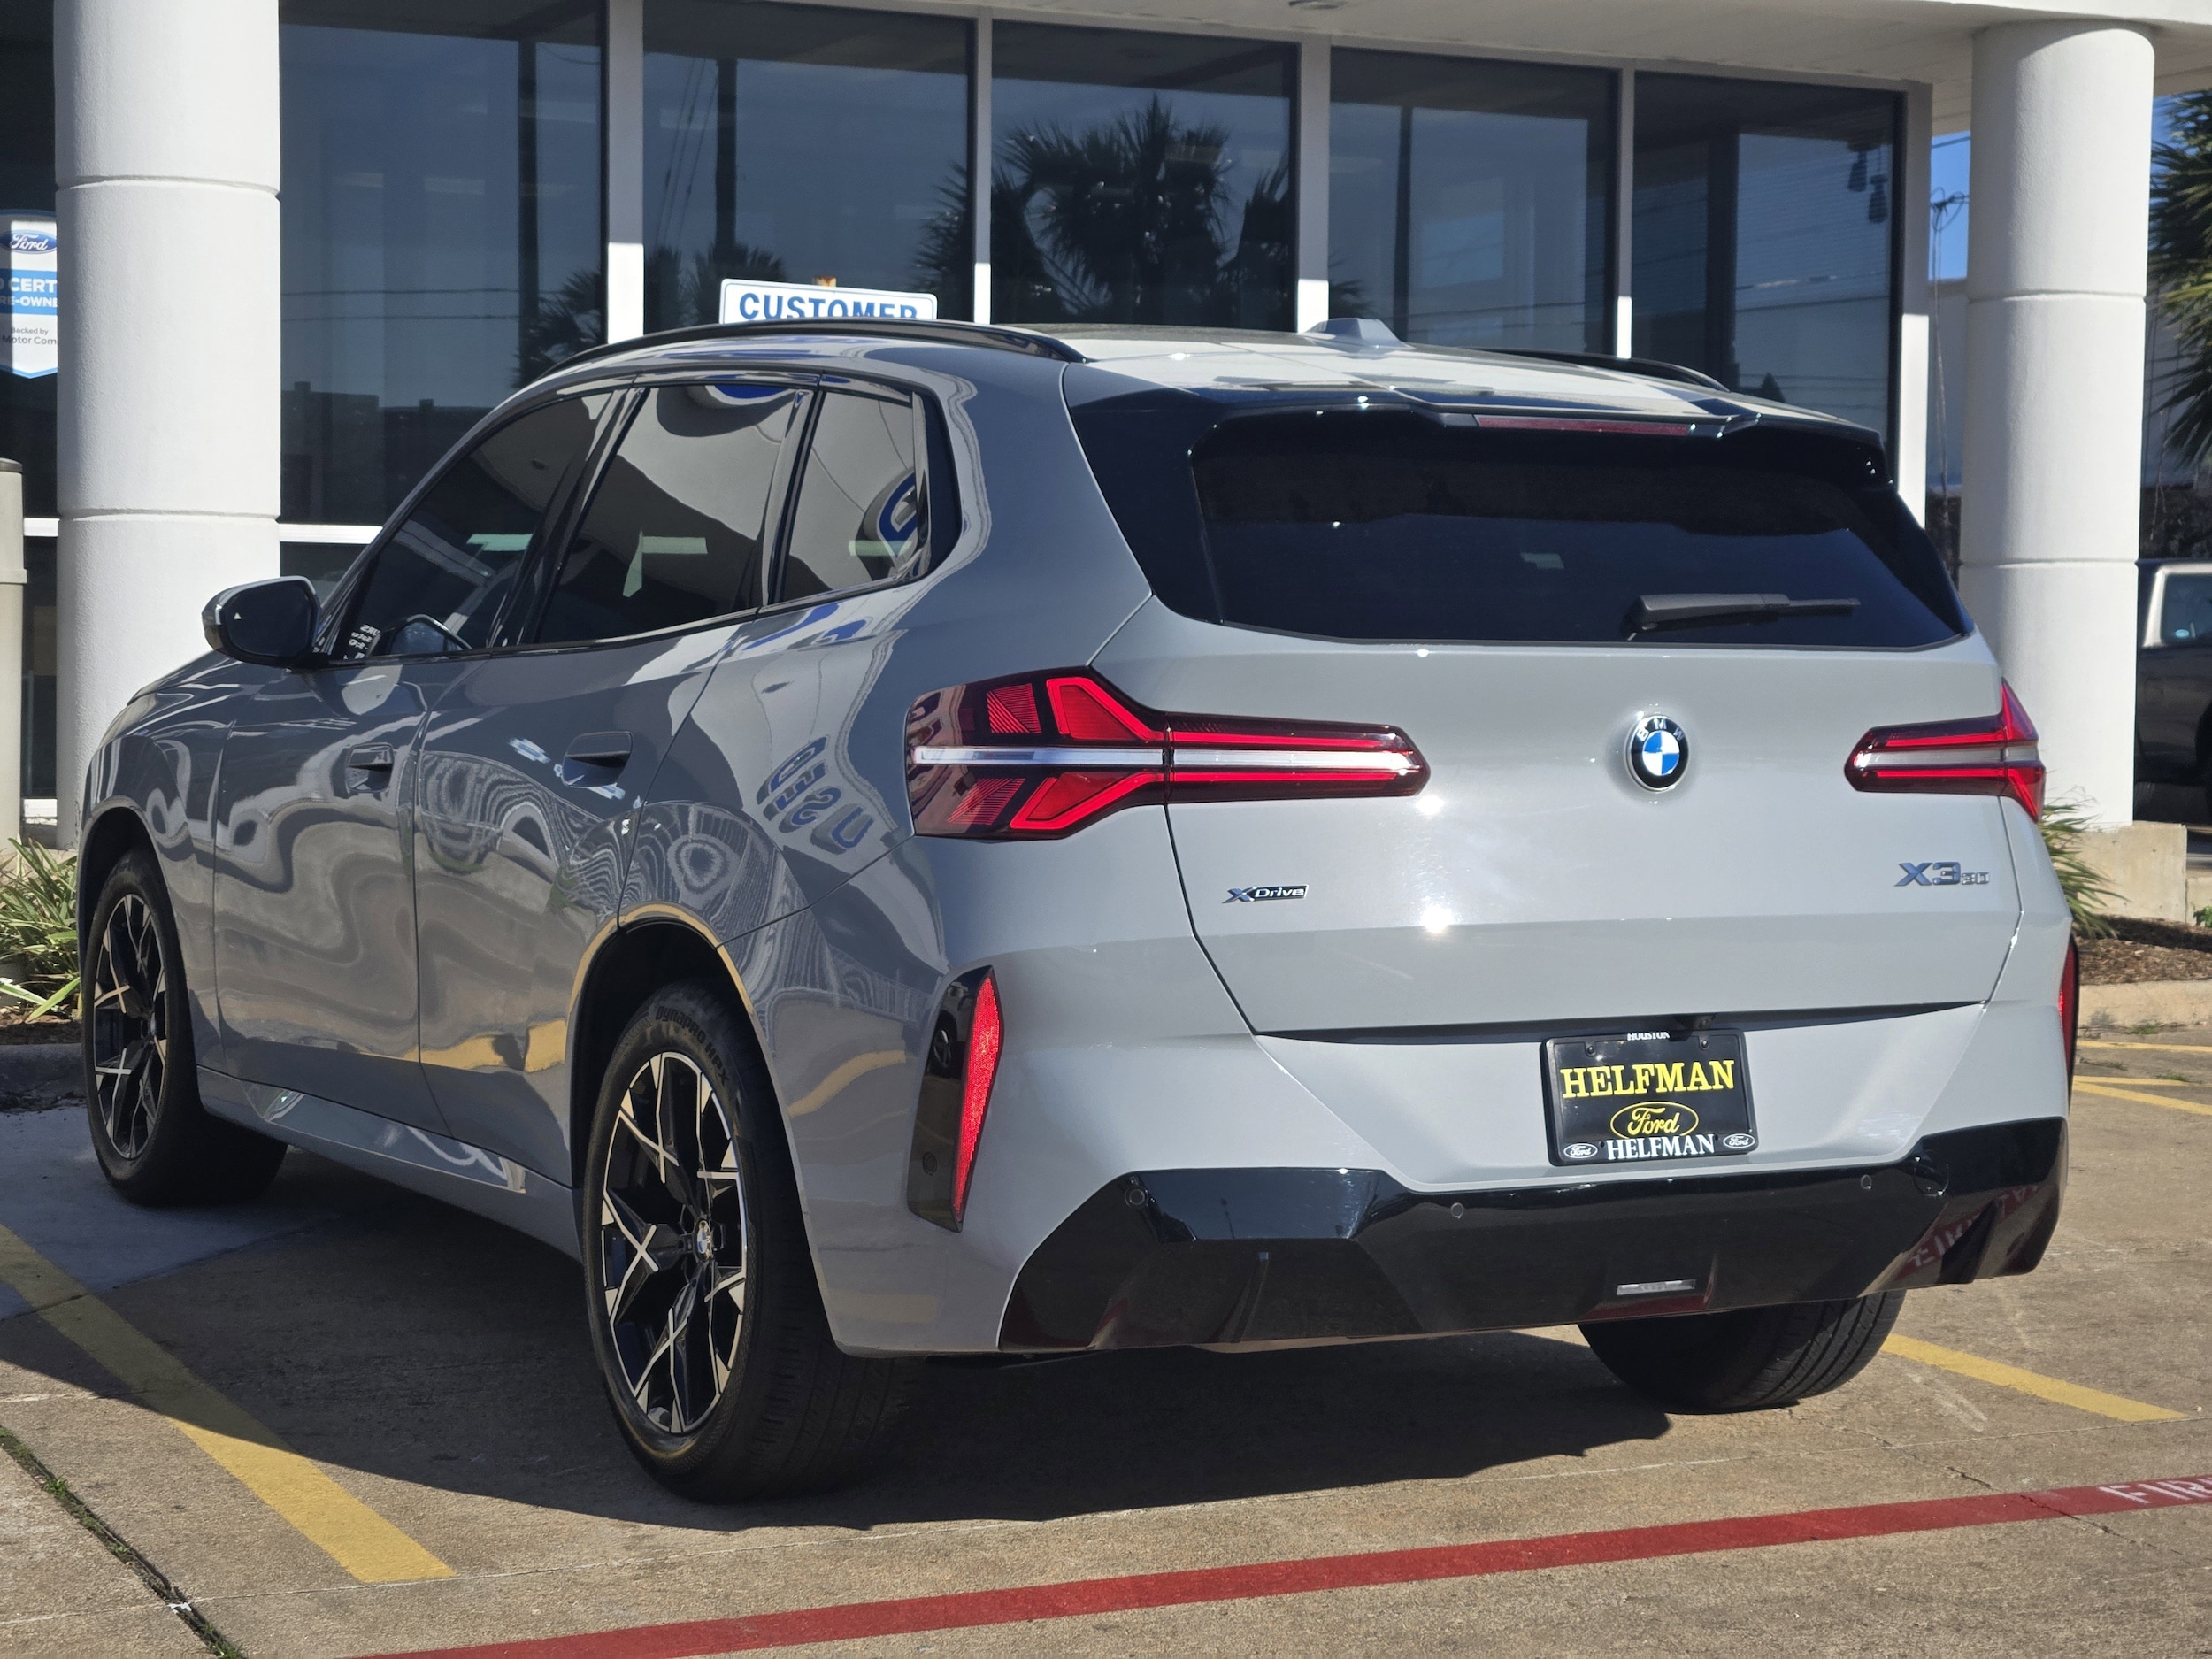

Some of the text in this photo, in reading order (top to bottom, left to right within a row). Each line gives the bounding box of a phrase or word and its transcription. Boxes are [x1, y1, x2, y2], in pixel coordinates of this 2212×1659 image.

[11, 233, 49, 250] Ford
[1636, 718, 1686, 741] BMW
[1560, 1059, 1734, 1099] HELFMAN
[1627, 1107, 1680, 1135] Ford
[1569, 1133, 1749, 1160] Ford HELFMAN Ford
